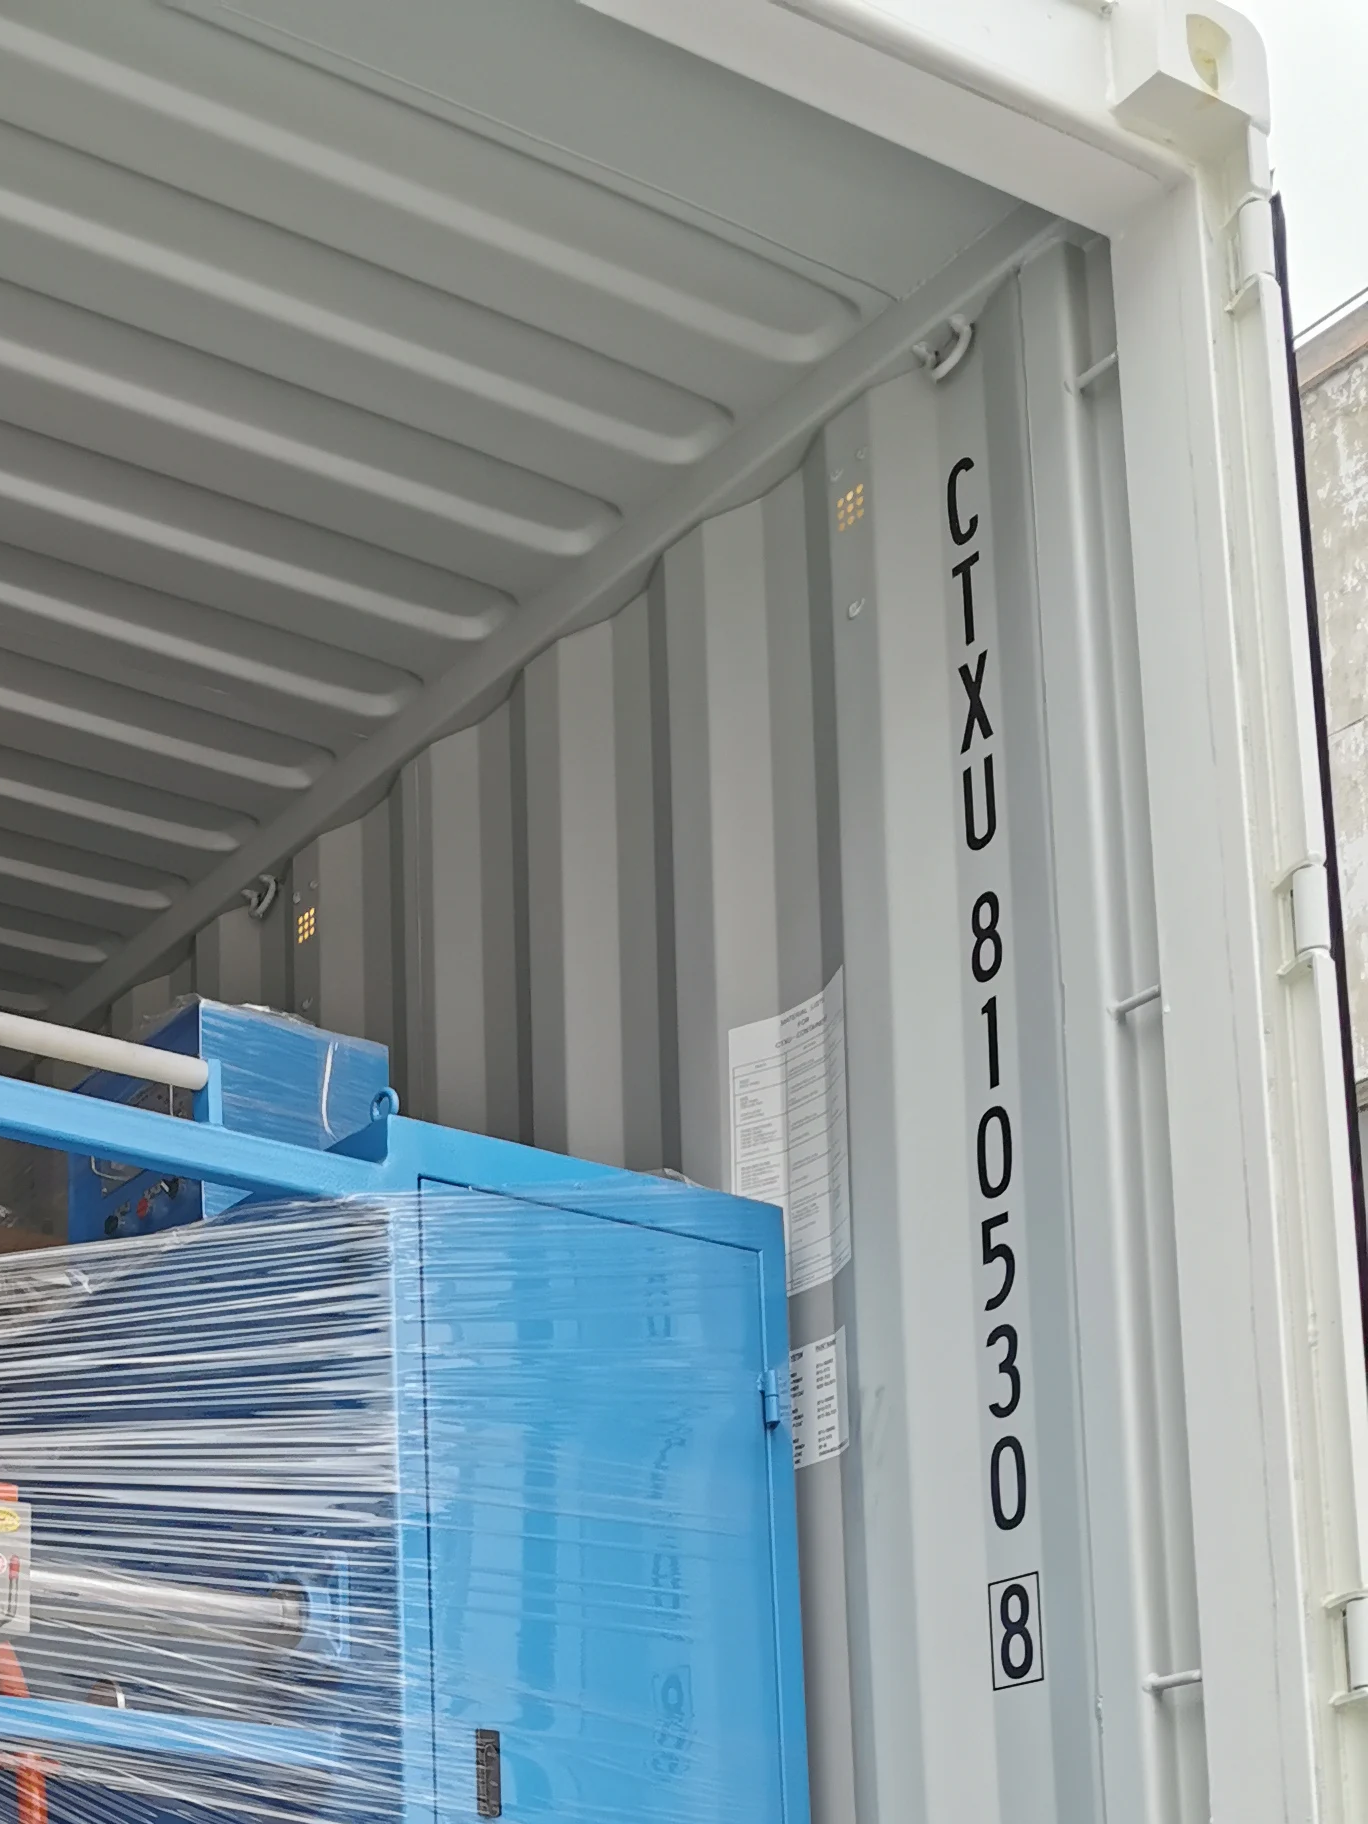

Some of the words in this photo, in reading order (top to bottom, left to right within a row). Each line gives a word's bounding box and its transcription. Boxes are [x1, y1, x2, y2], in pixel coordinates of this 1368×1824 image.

[947, 456, 997, 851] CTXU
[971, 890, 1027, 1531] 810530
[999, 1583, 1034, 1680] 8
